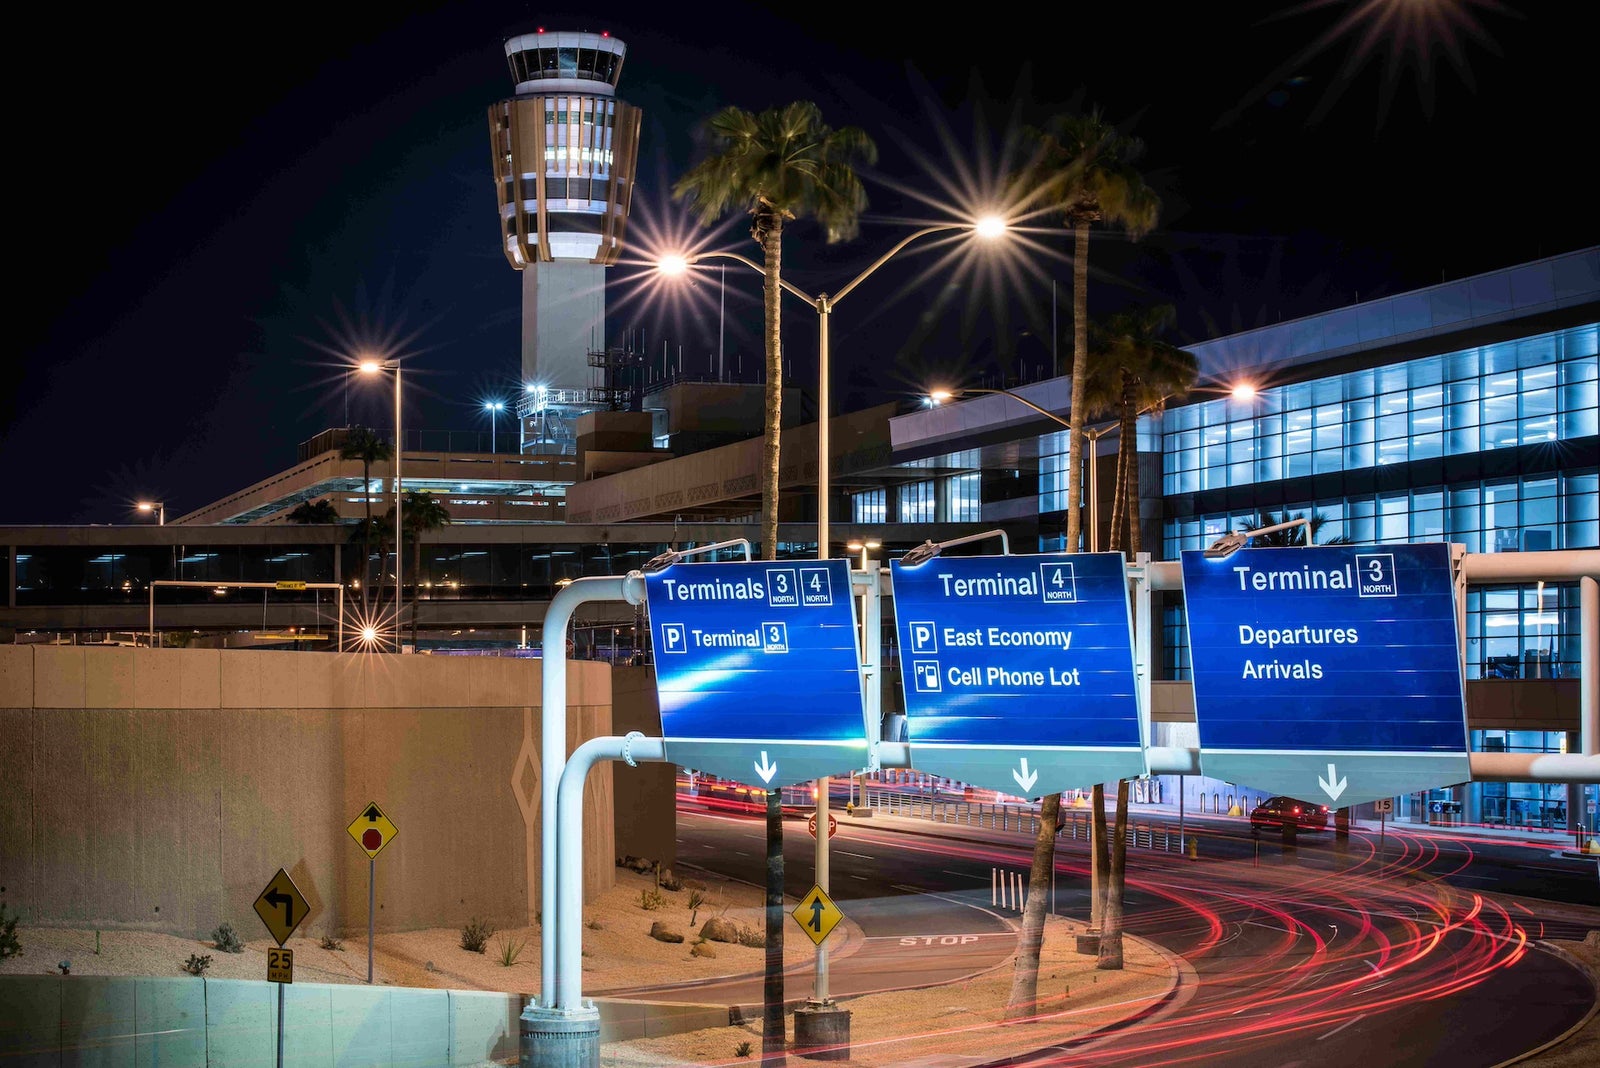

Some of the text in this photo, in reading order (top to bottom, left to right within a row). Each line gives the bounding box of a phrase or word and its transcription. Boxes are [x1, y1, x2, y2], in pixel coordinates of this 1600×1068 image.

[938, 568, 1064, 597] Terminal 4
[1233, 559, 1383, 590] Terminal 3
[663, 573, 821, 601] Terminals 3 4
[1047, 591, 1072, 599] NORTH
[1363, 584, 1392, 593] NORTH
[772, 595, 794, 603] NORTH
[806, 595, 828, 603] NORTH
[667, 626, 780, 648] P Terminal 3
[915, 626, 1072, 650] P East Economy
[1238, 625, 1359, 649] Departures
[948, 667, 982, 686] Cell
[987, 667, 1045, 686] Phone
[1049, 667, 1081, 686] Lot
[1242, 659, 1324, 679] Arrivals
[809, 820, 836, 832] SP
[899, 935, 979, 946] STOP
[270, 952, 291, 970] 25
